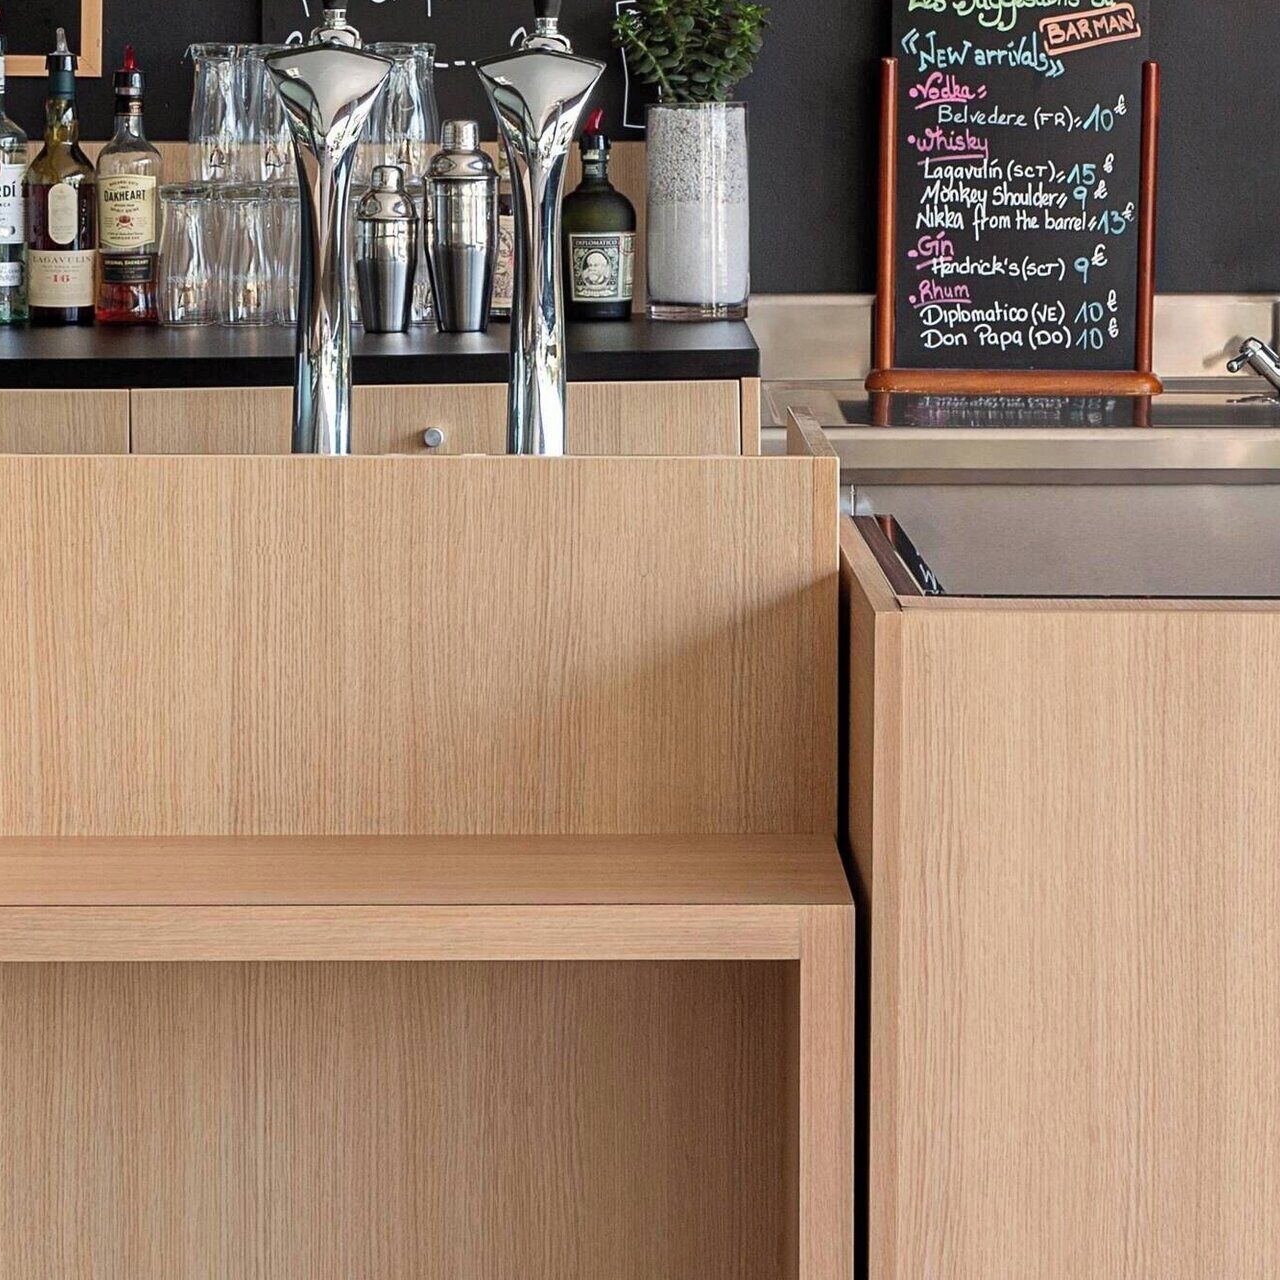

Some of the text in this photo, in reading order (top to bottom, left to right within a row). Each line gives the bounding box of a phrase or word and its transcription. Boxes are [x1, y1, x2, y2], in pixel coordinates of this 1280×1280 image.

[1046, 9, 1135, 45] BARMAN
[938, 105, 1028, 127] Belvedere
[1034, 105, 1074, 132] (FR)
[923, 157, 1003, 191] Lagavulin
[104, 189, 146, 202] OAKHEART
[920, 180, 988, 208] Monkey
[992, 181, 1058, 207] Shoulder
[915, 204, 965, 230] Nikka
[972, 203, 1011, 242] from
[1015, 208, 1040, 230] the
[1044, 210, 1086, 232] barrel
[917, 230, 954, 257] Gin
[931, 255, 1021, 278] Hendrick's
[918, 278, 970, 303] Rhum
[920, 300, 1029, 328] Diplomatico
[920, 328, 967, 349] Don
[973, 323, 1023, 351] Papa
[1028, 325, 1072, 350] (DO)
